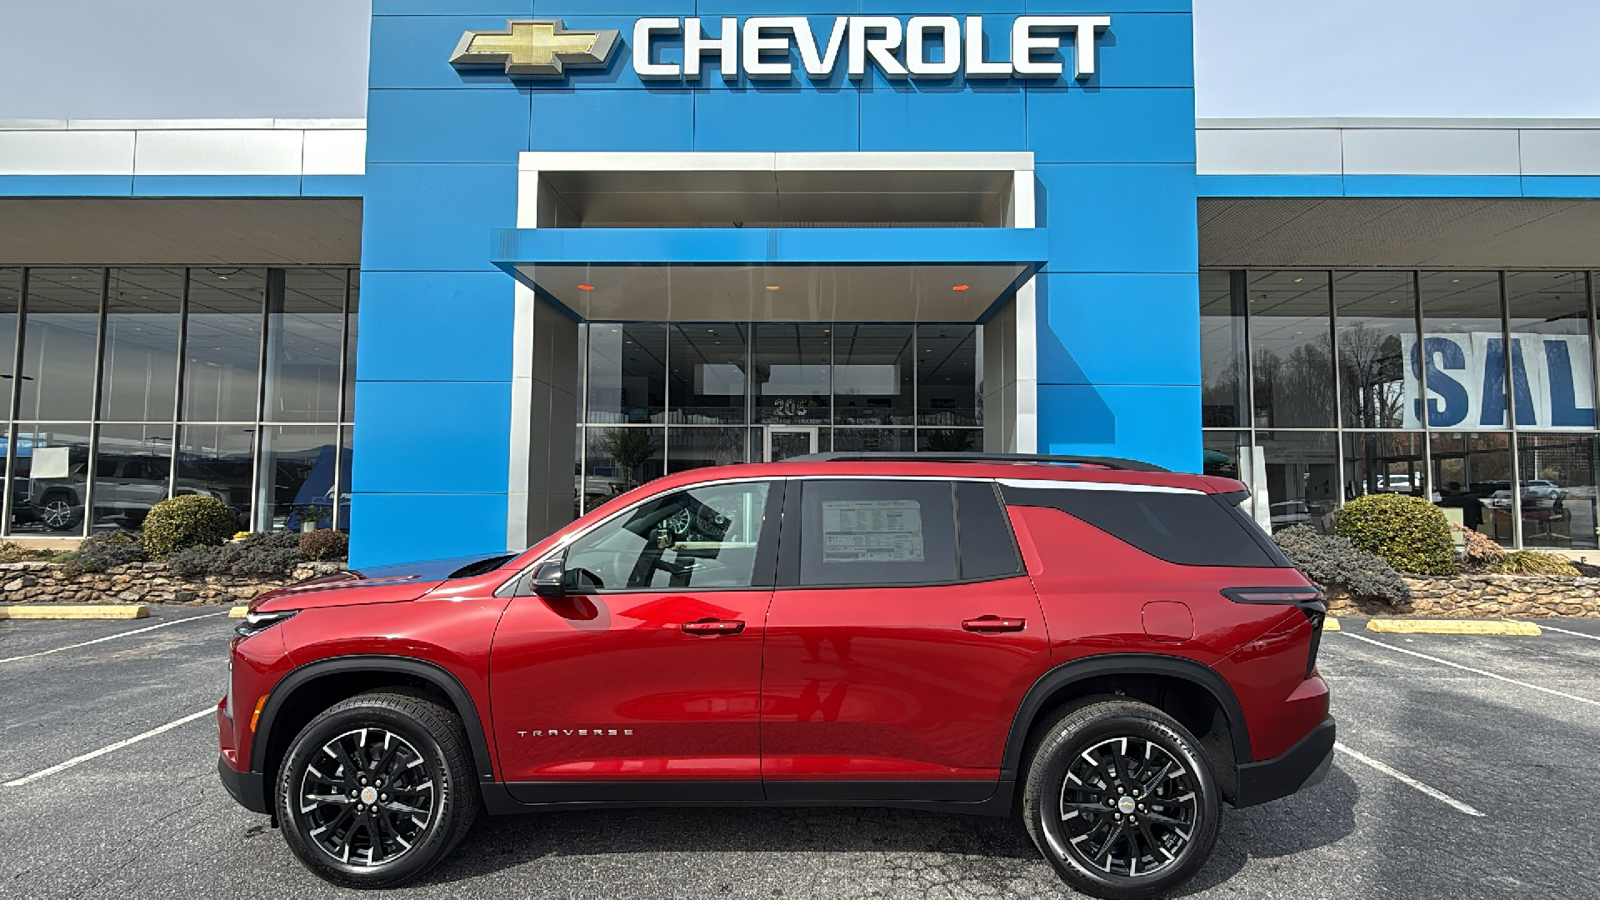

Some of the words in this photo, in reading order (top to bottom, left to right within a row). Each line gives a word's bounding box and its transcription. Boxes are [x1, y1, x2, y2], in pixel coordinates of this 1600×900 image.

[632, 16, 1111, 81] CHEVROLET
[773, 398, 808, 416] 205
[517, 729, 634, 738] TRAVERSE
